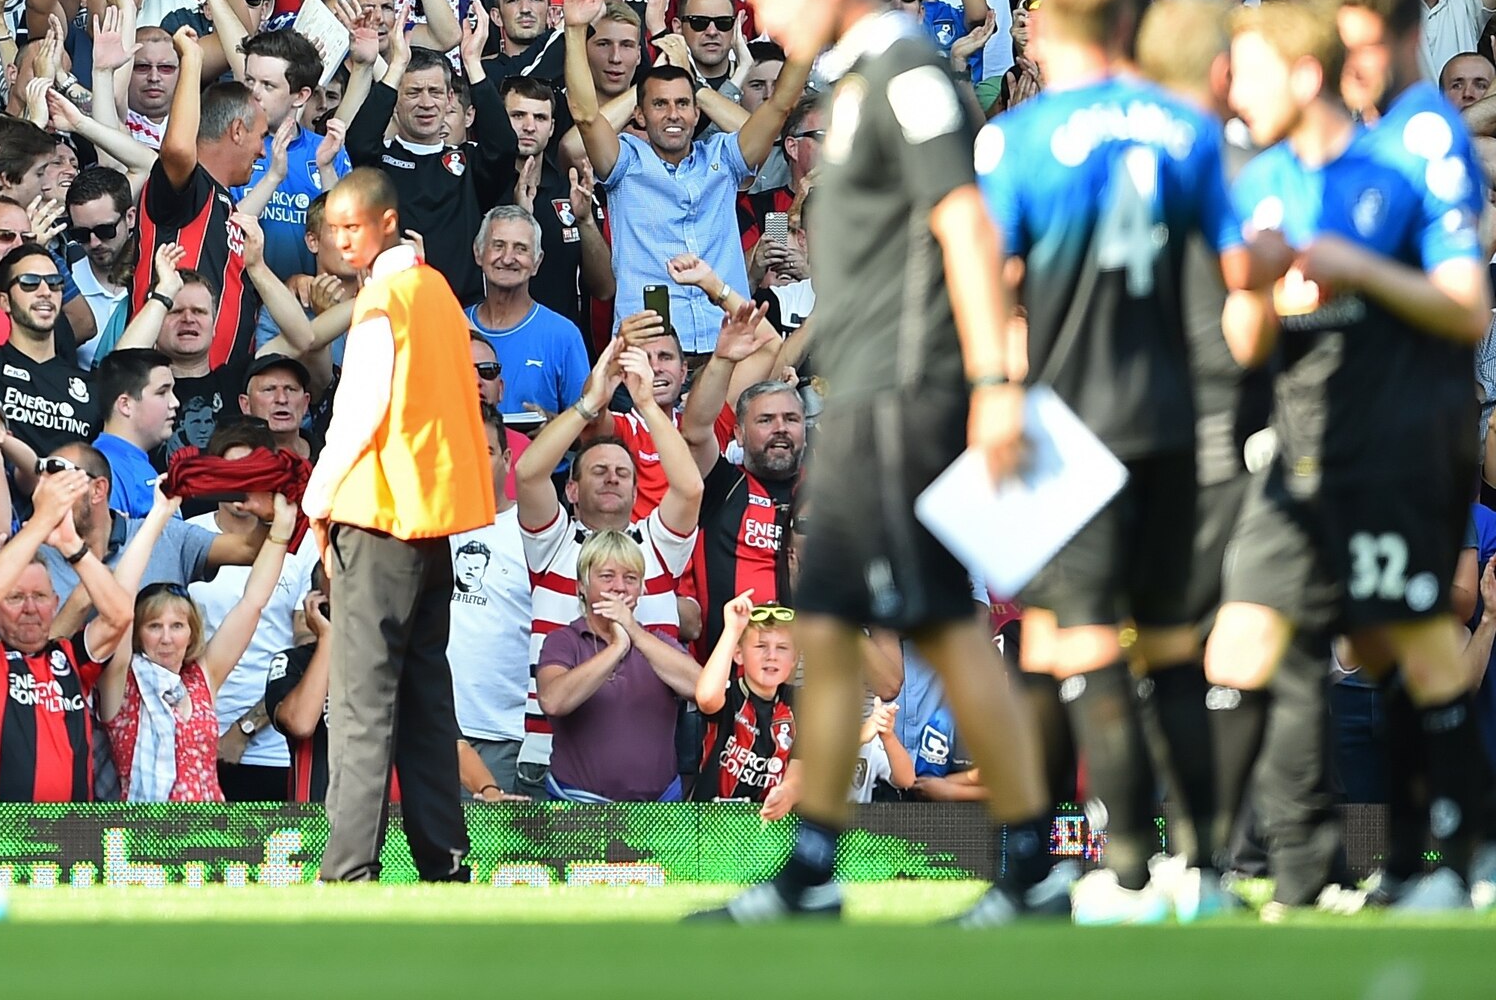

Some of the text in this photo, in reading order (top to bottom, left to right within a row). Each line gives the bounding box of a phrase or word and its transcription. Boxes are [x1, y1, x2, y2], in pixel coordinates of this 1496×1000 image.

[1098, 146, 1160, 298] 4
[5, 387, 61, 414] ENERGY
[3, 404, 91, 437] CONSULTING
[745, 519, 783, 538] ENER
[1349, 532, 1408, 600] 32
[462, 594, 488, 606] FLETCH
